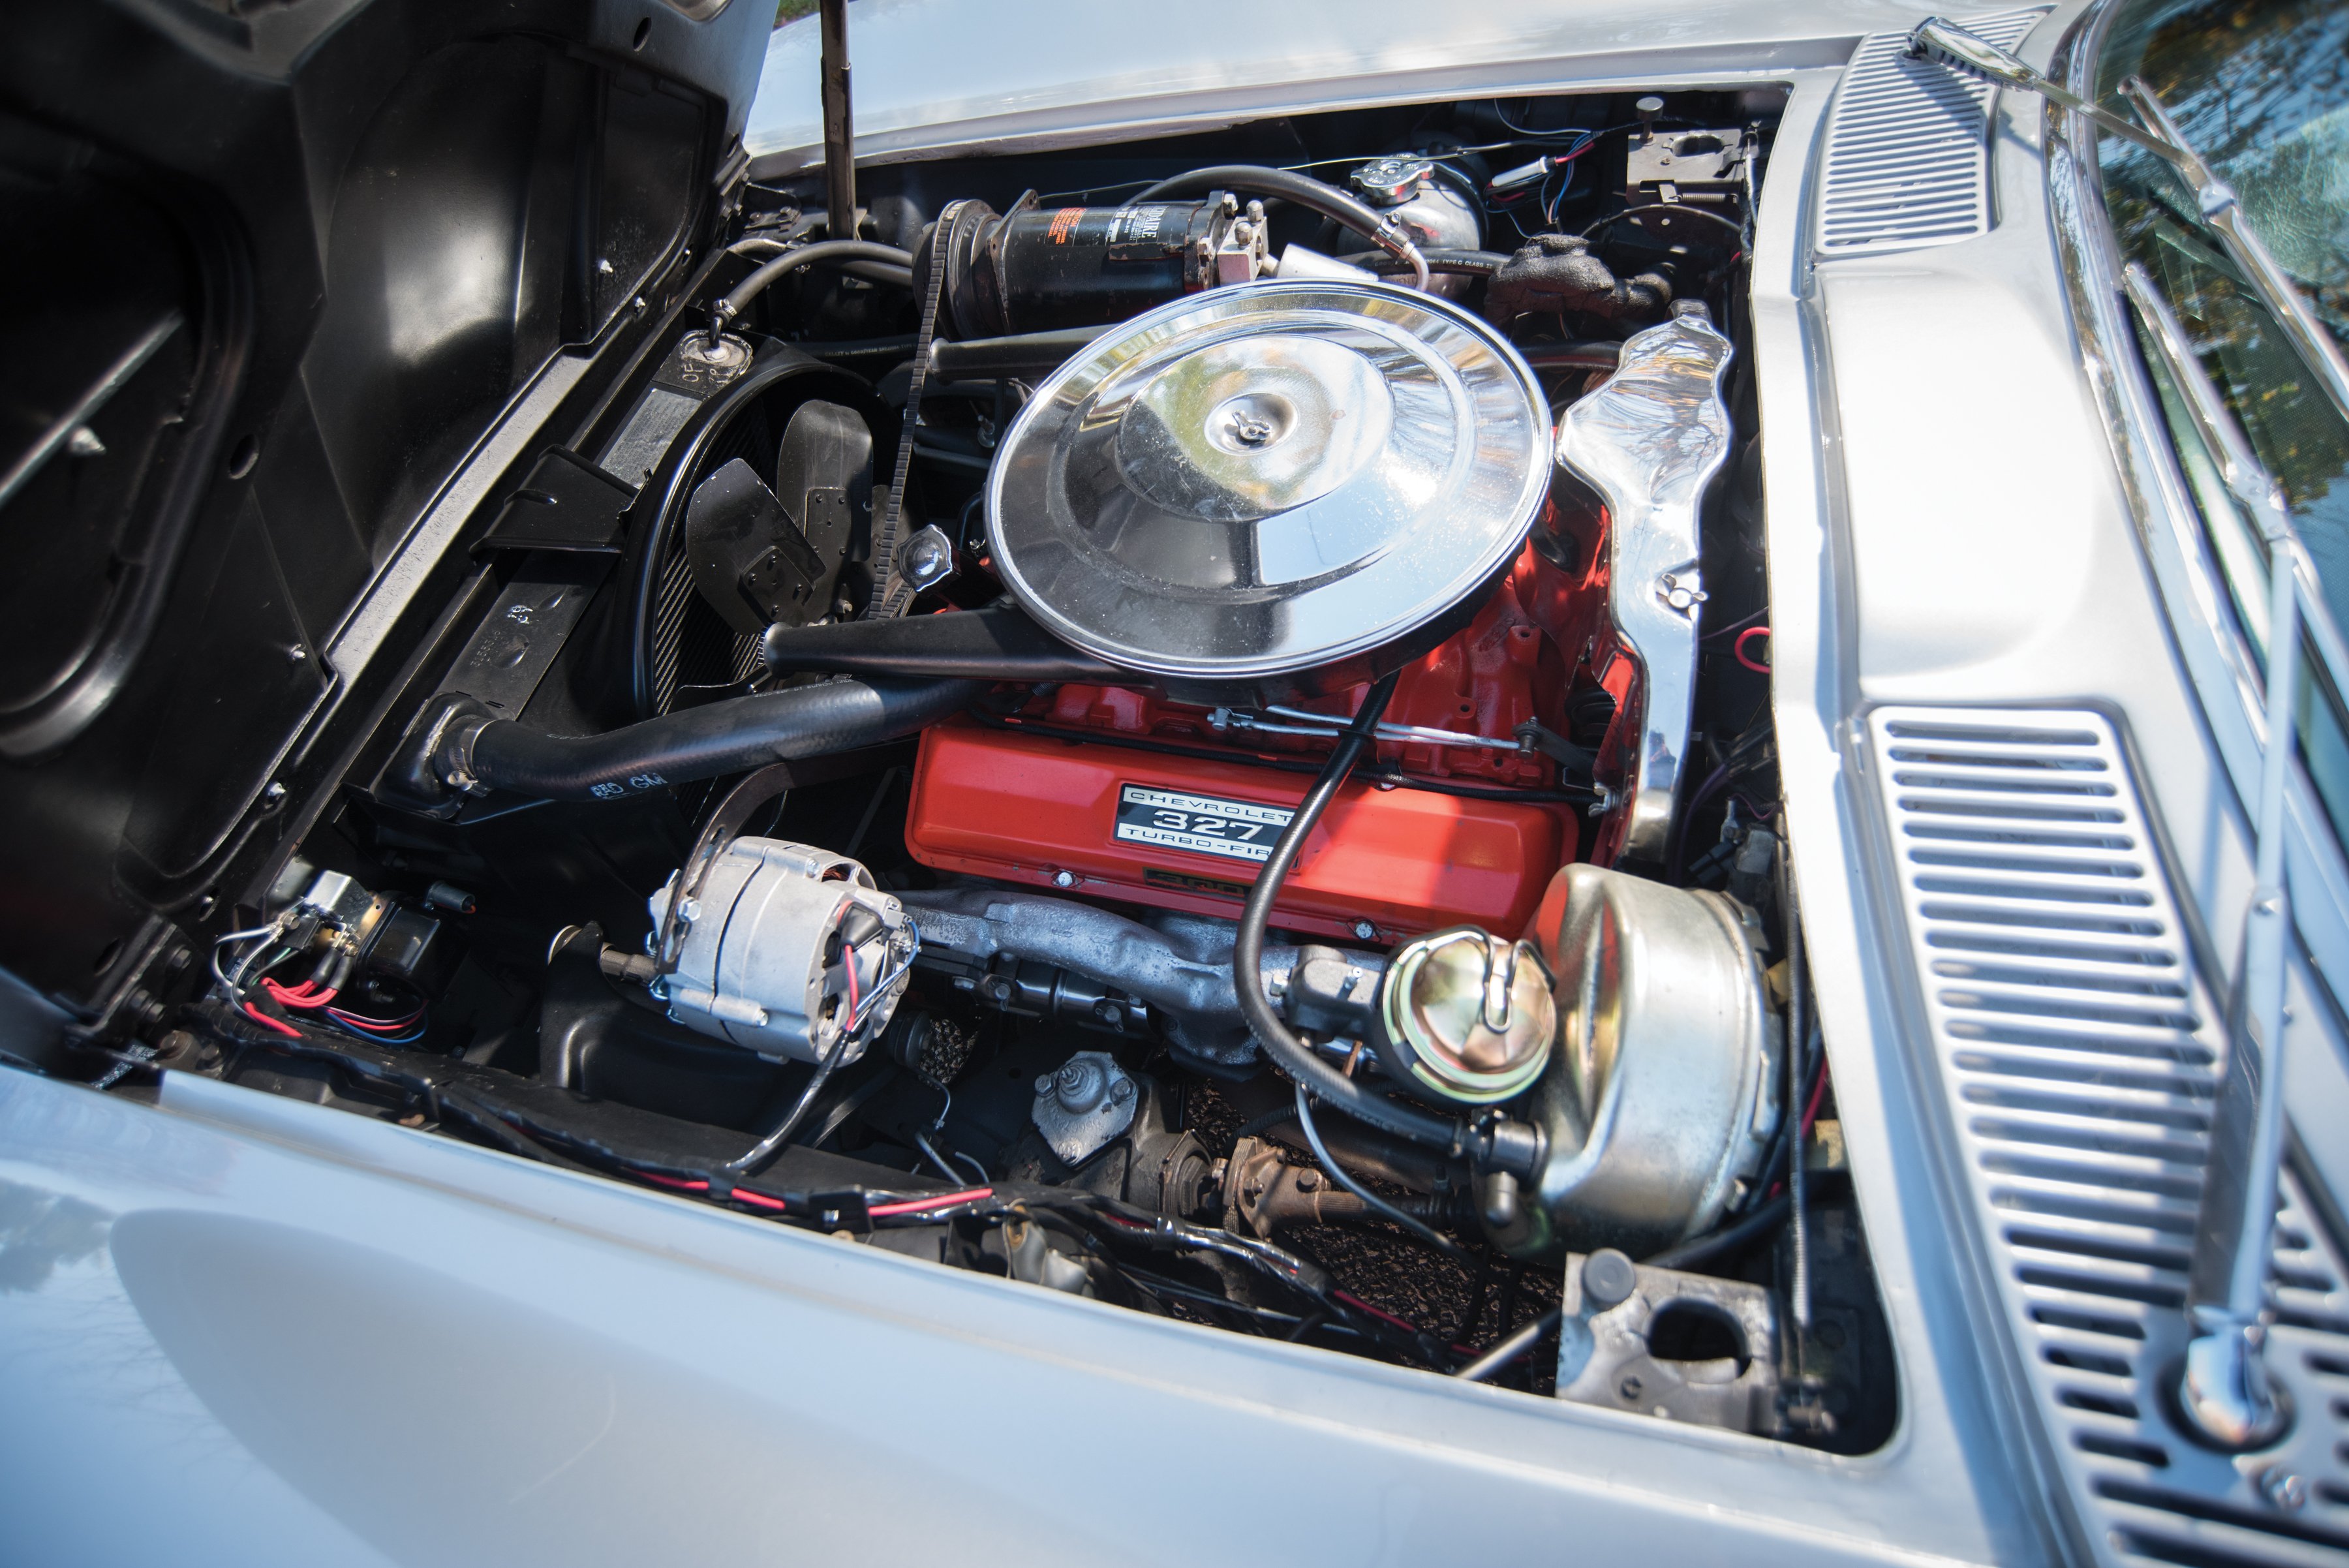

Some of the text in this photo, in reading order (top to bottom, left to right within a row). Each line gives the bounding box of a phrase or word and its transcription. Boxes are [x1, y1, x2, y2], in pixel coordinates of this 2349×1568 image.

[630, 773, 668, 789] GM
[1130, 792, 1295, 822] CHEVROLET
[1153, 809, 1264, 840] 327
[1126, 828, 1270, 857] TURBO-FIR
